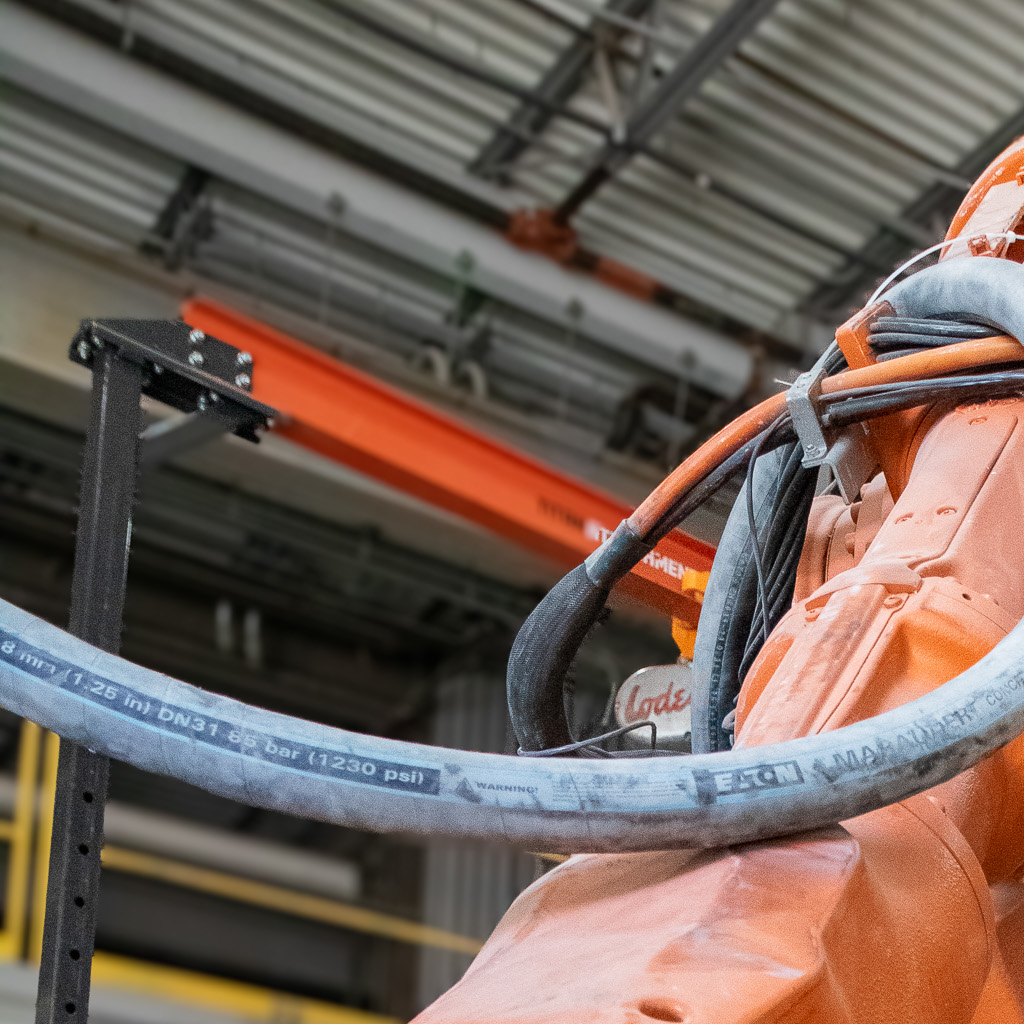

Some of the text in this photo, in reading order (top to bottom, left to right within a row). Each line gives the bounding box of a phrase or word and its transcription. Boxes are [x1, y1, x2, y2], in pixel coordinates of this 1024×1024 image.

[20, 652, 57, 675] mm
[65, 668, 117, 700] (1.25
[123, 695, 152, 716] in)
[157, 705, 219, 738] DN31
[265, 739, 301, 763] bar
[308, 749, 377, 778] (1230
[384, 767, 425, 787] psi)
[624, 682, 692, 723] Lode
[475, 781, 539, 795] WARNING!
